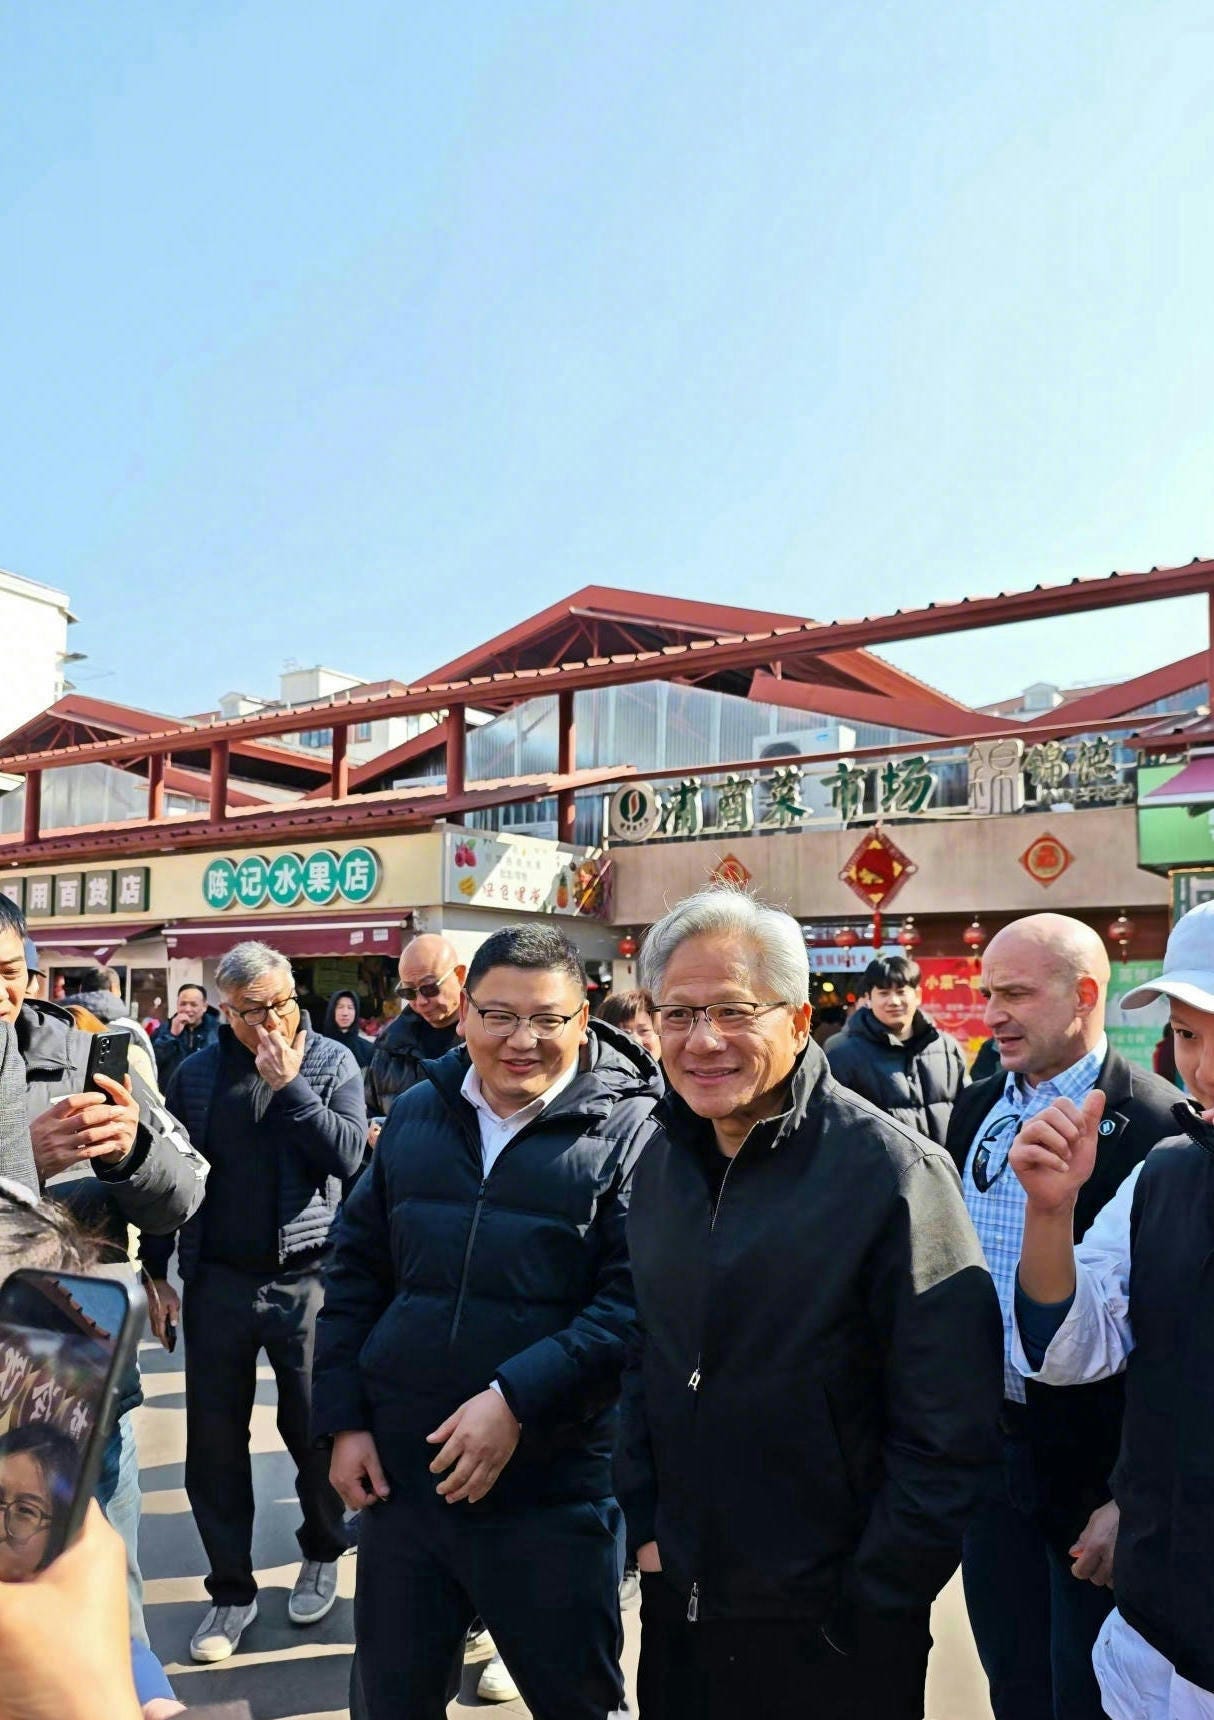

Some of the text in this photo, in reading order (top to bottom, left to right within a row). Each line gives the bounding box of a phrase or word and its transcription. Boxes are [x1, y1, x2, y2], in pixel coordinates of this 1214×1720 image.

[207, 859, 369, 900] 陈记水果店
